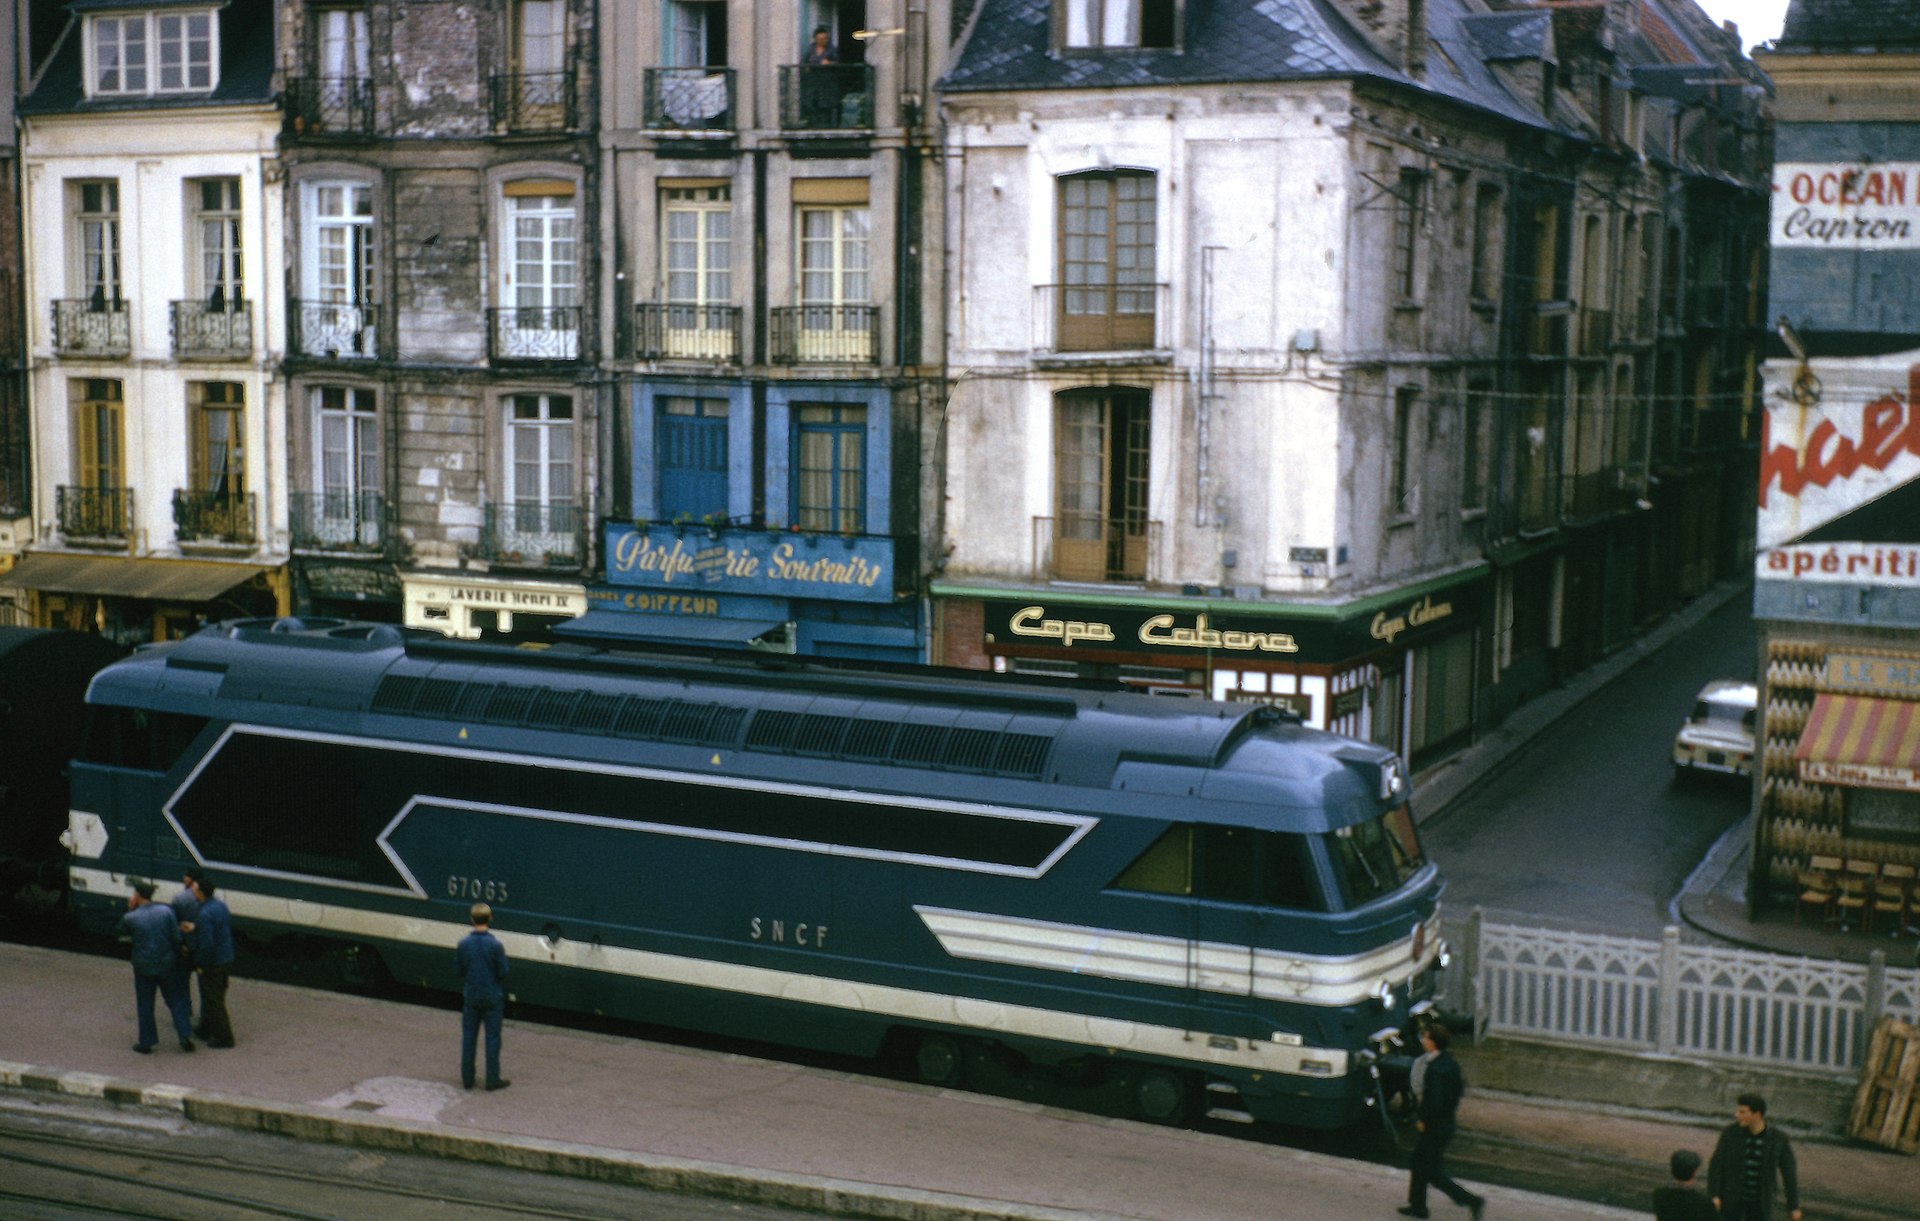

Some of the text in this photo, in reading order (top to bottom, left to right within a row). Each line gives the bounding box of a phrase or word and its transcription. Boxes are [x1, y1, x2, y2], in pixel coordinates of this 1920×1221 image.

[1790, 169, 1906, 206] OCEAN
[1783, 206, 1910, 243] Capron
[615, 530, 760, 583] Parfurie
[767, 543, 881, 588] Souvenirs
[450, 587, 508, 604] LAVERIE
[511, 592, 552, 606] Henri
[1009, 606, 1299, 652] Copa Cabana
[750, 916, 829, 948] SNCF
